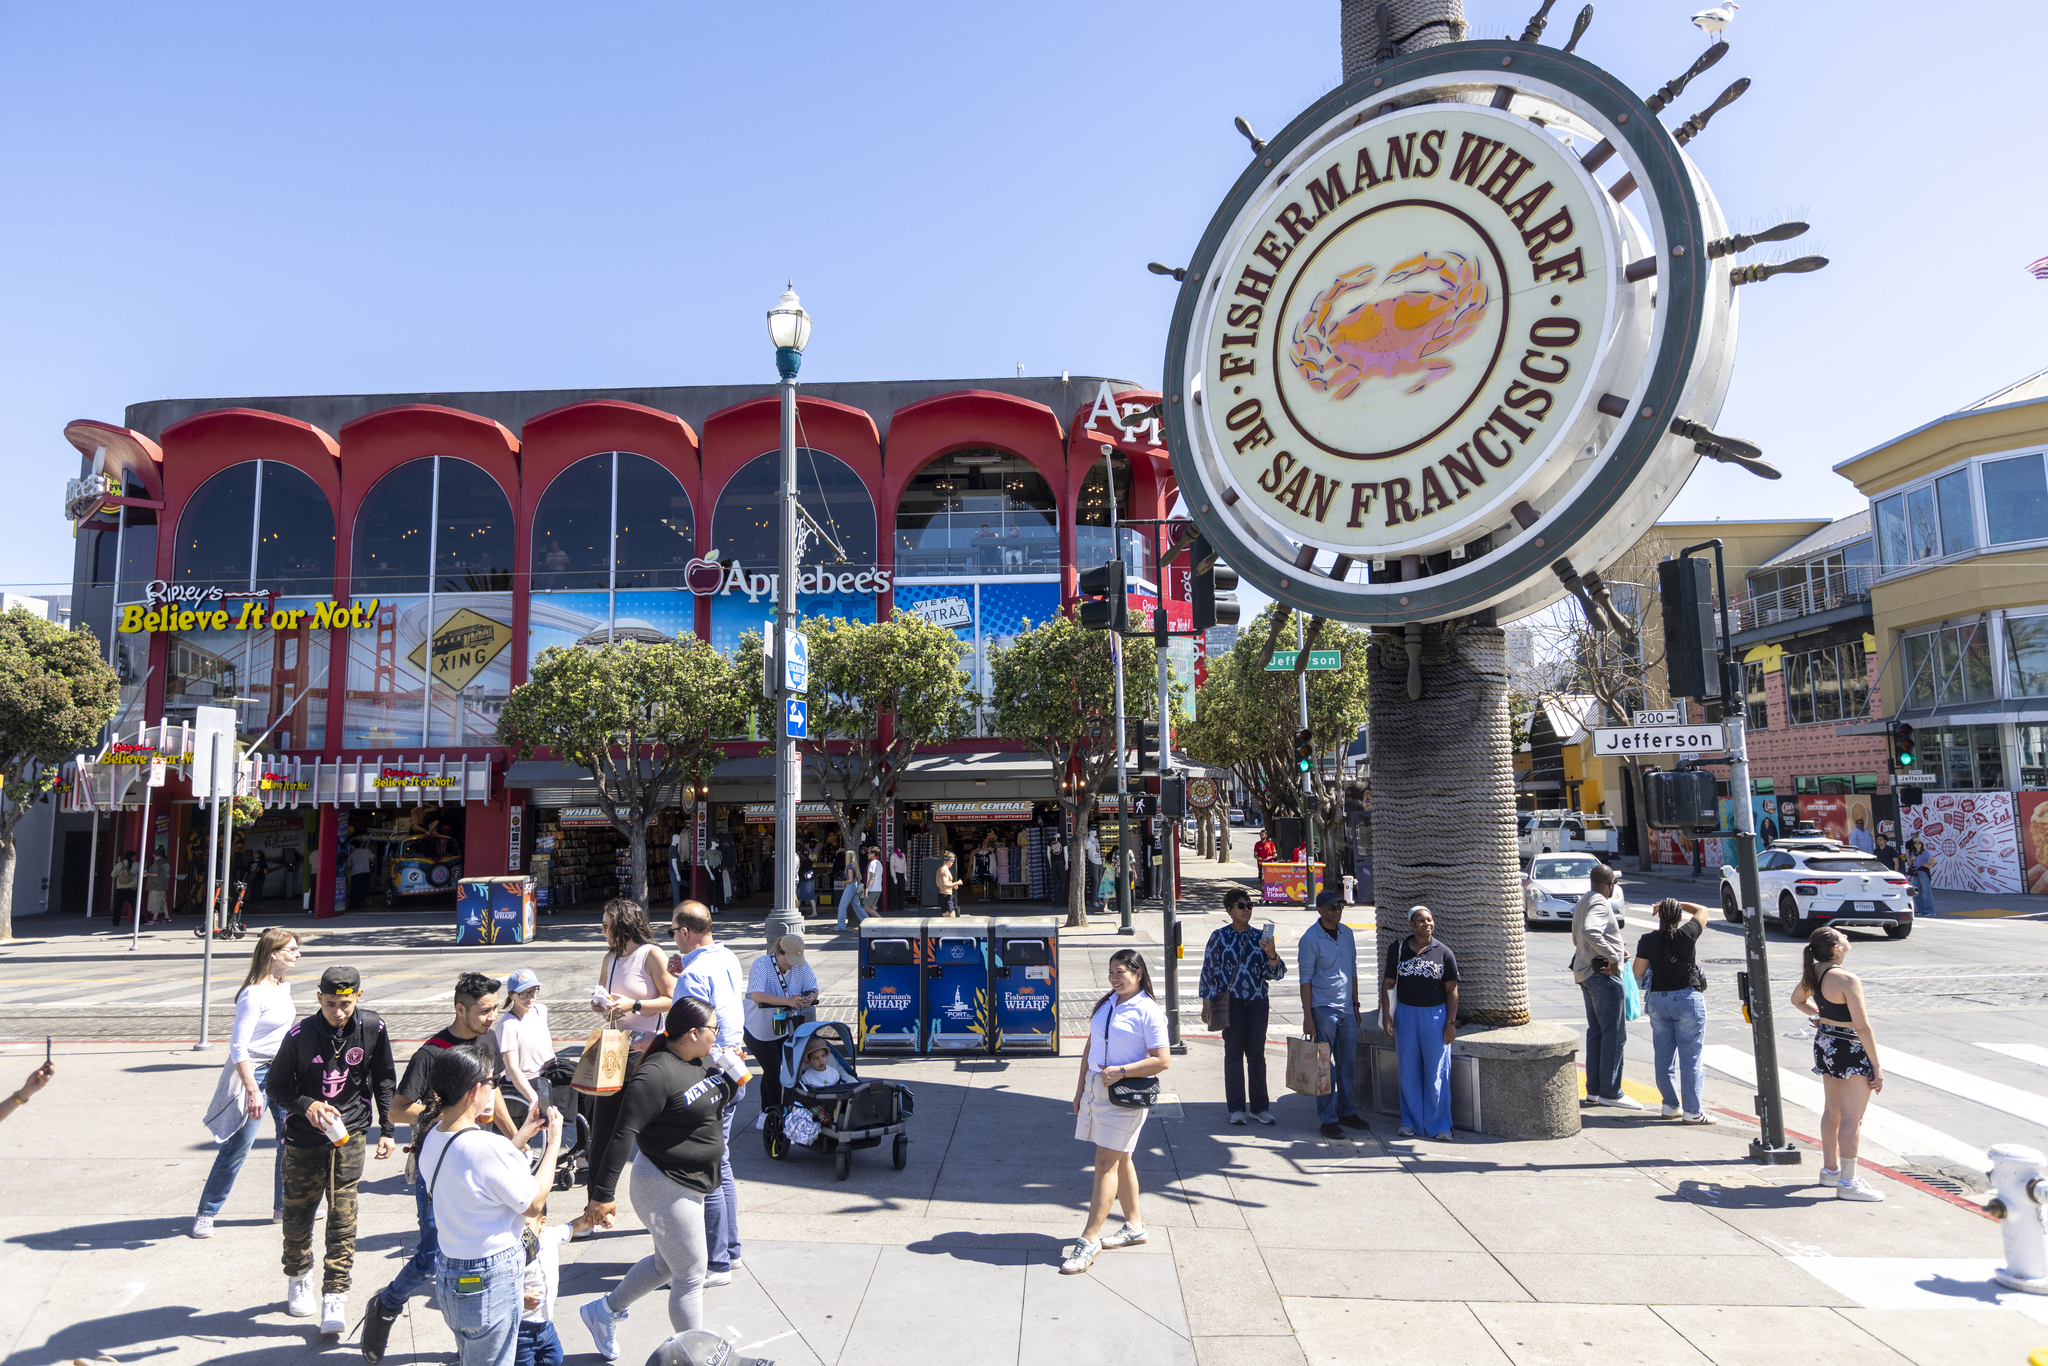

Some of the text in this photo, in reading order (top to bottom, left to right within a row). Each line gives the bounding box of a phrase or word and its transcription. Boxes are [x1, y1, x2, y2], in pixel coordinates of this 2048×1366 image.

[1220, 128, 1586, 382] FISHERMANS WHARF
[1225, 317, 1583, 528] OF SAN FRANCISCO
[720, 559, 890, 603] Appebee's
[914, 598, 947, 609] VIEW
[118, 598, 379, 633] Believe It or Not!
[916, 604, 967, 621] ATRAZ
[439, 649, 485, 673] XING
[1269, 656, 1336, 667] Jeffson
[1639, 713, 1664, 724] 200
[1607, 733, 1712, 749] Jefferson
[101, 751, 147, 765] Believe
[166, 755, 180, 764] or
[373, 776, 455, 787] Believe It or Not!
[750, 805, 777, 813] WHA
[938, 802, 1026, 811] WHARF CENTRAL
[1993, 808, 2012, 825] Eat
[867, 991, 911, 1000] Fisherman's
[1004, 992, 1050, 1000] Fisherman's
[867, 1000, 911, 1010] WHARF
[1004, 1000, 1050, 1011] WHARF
[683, 1080, 708, 1106] NEW
